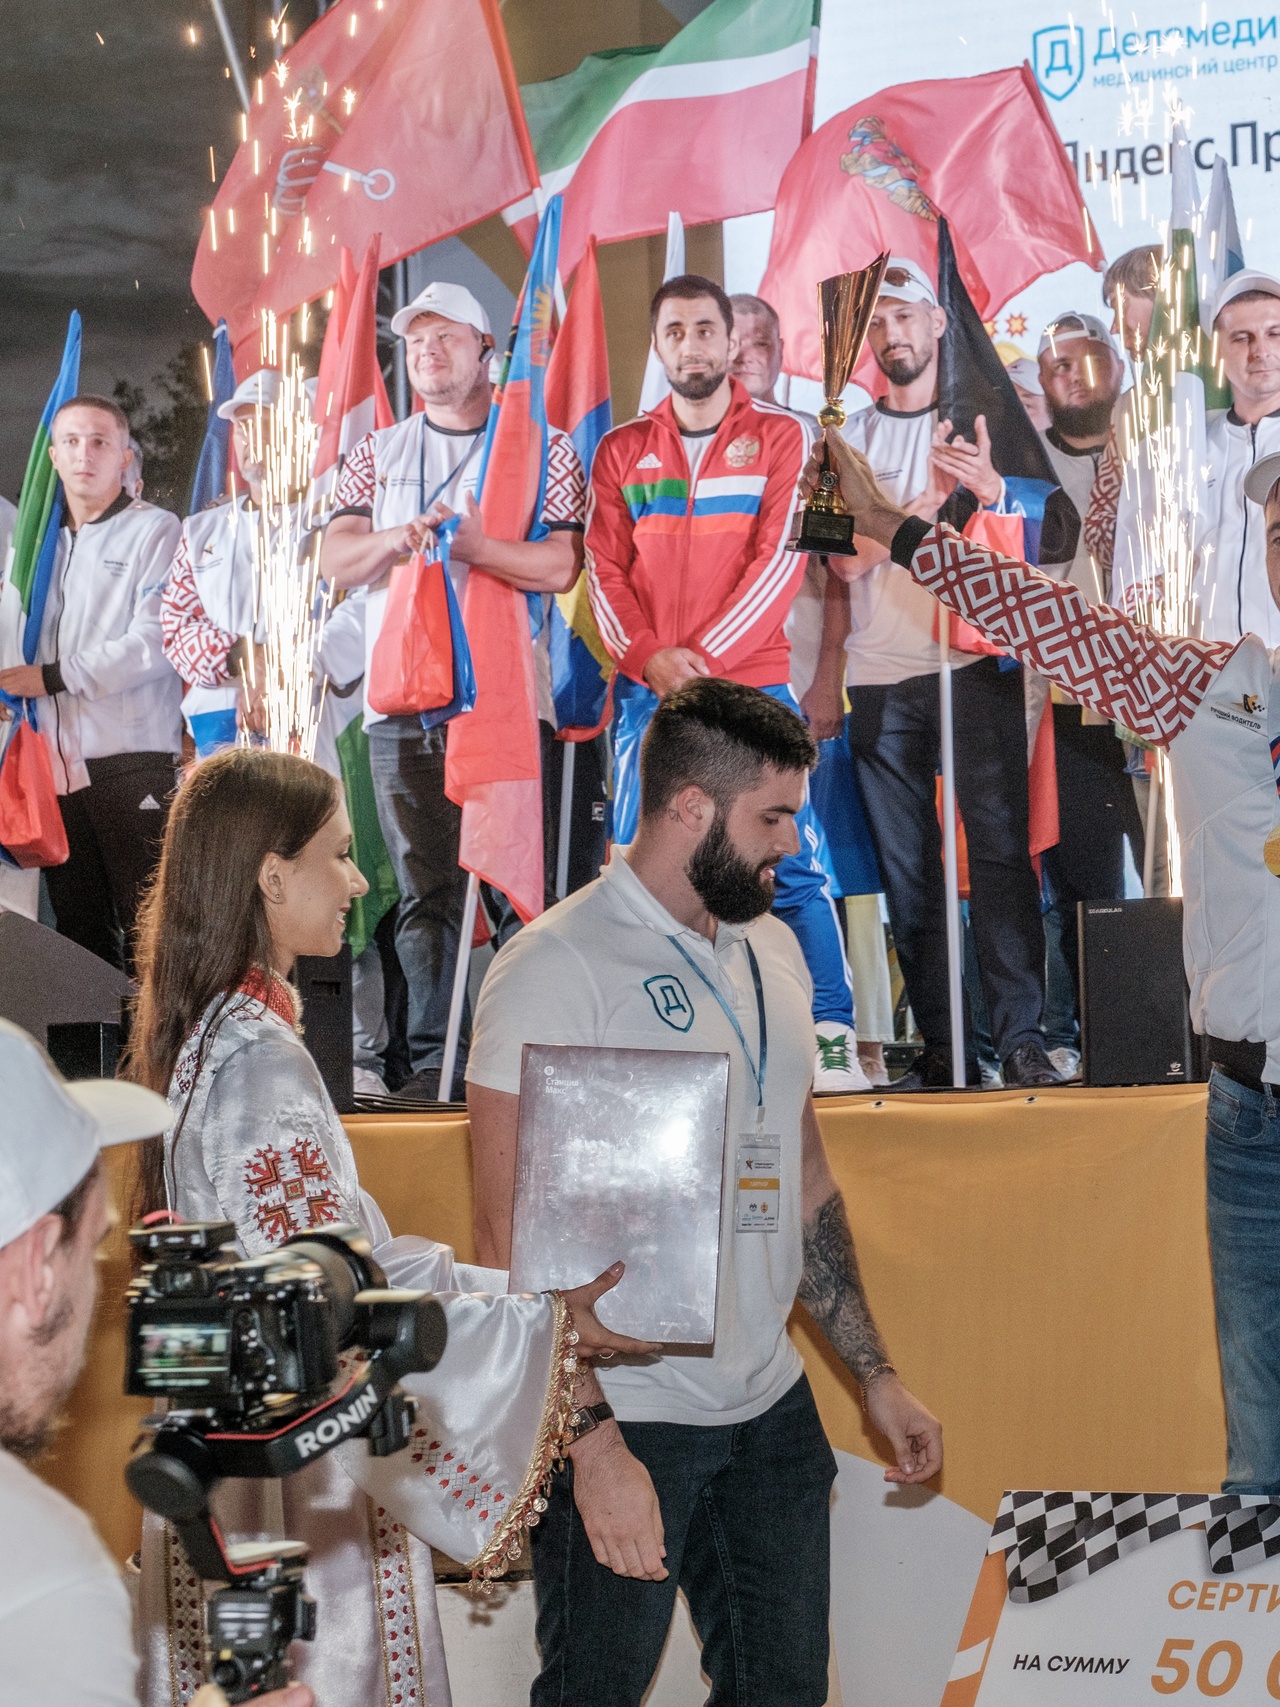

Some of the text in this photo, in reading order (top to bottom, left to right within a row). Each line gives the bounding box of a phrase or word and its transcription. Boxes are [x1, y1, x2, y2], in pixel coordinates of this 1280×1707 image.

[1223, 54, 1279, 72] центр
[1231, 714, 1262, 729] ВОДИТЕЛЬ
[660, 985, 687, 1016] Д
[545, 1077, 579, 1087] Станция
[294, 1383, 379, 1459] RONIN
[1013, 1653, 1131, 1674] НА СУММУ
[1150, 1638, 1244, 1698] 50
